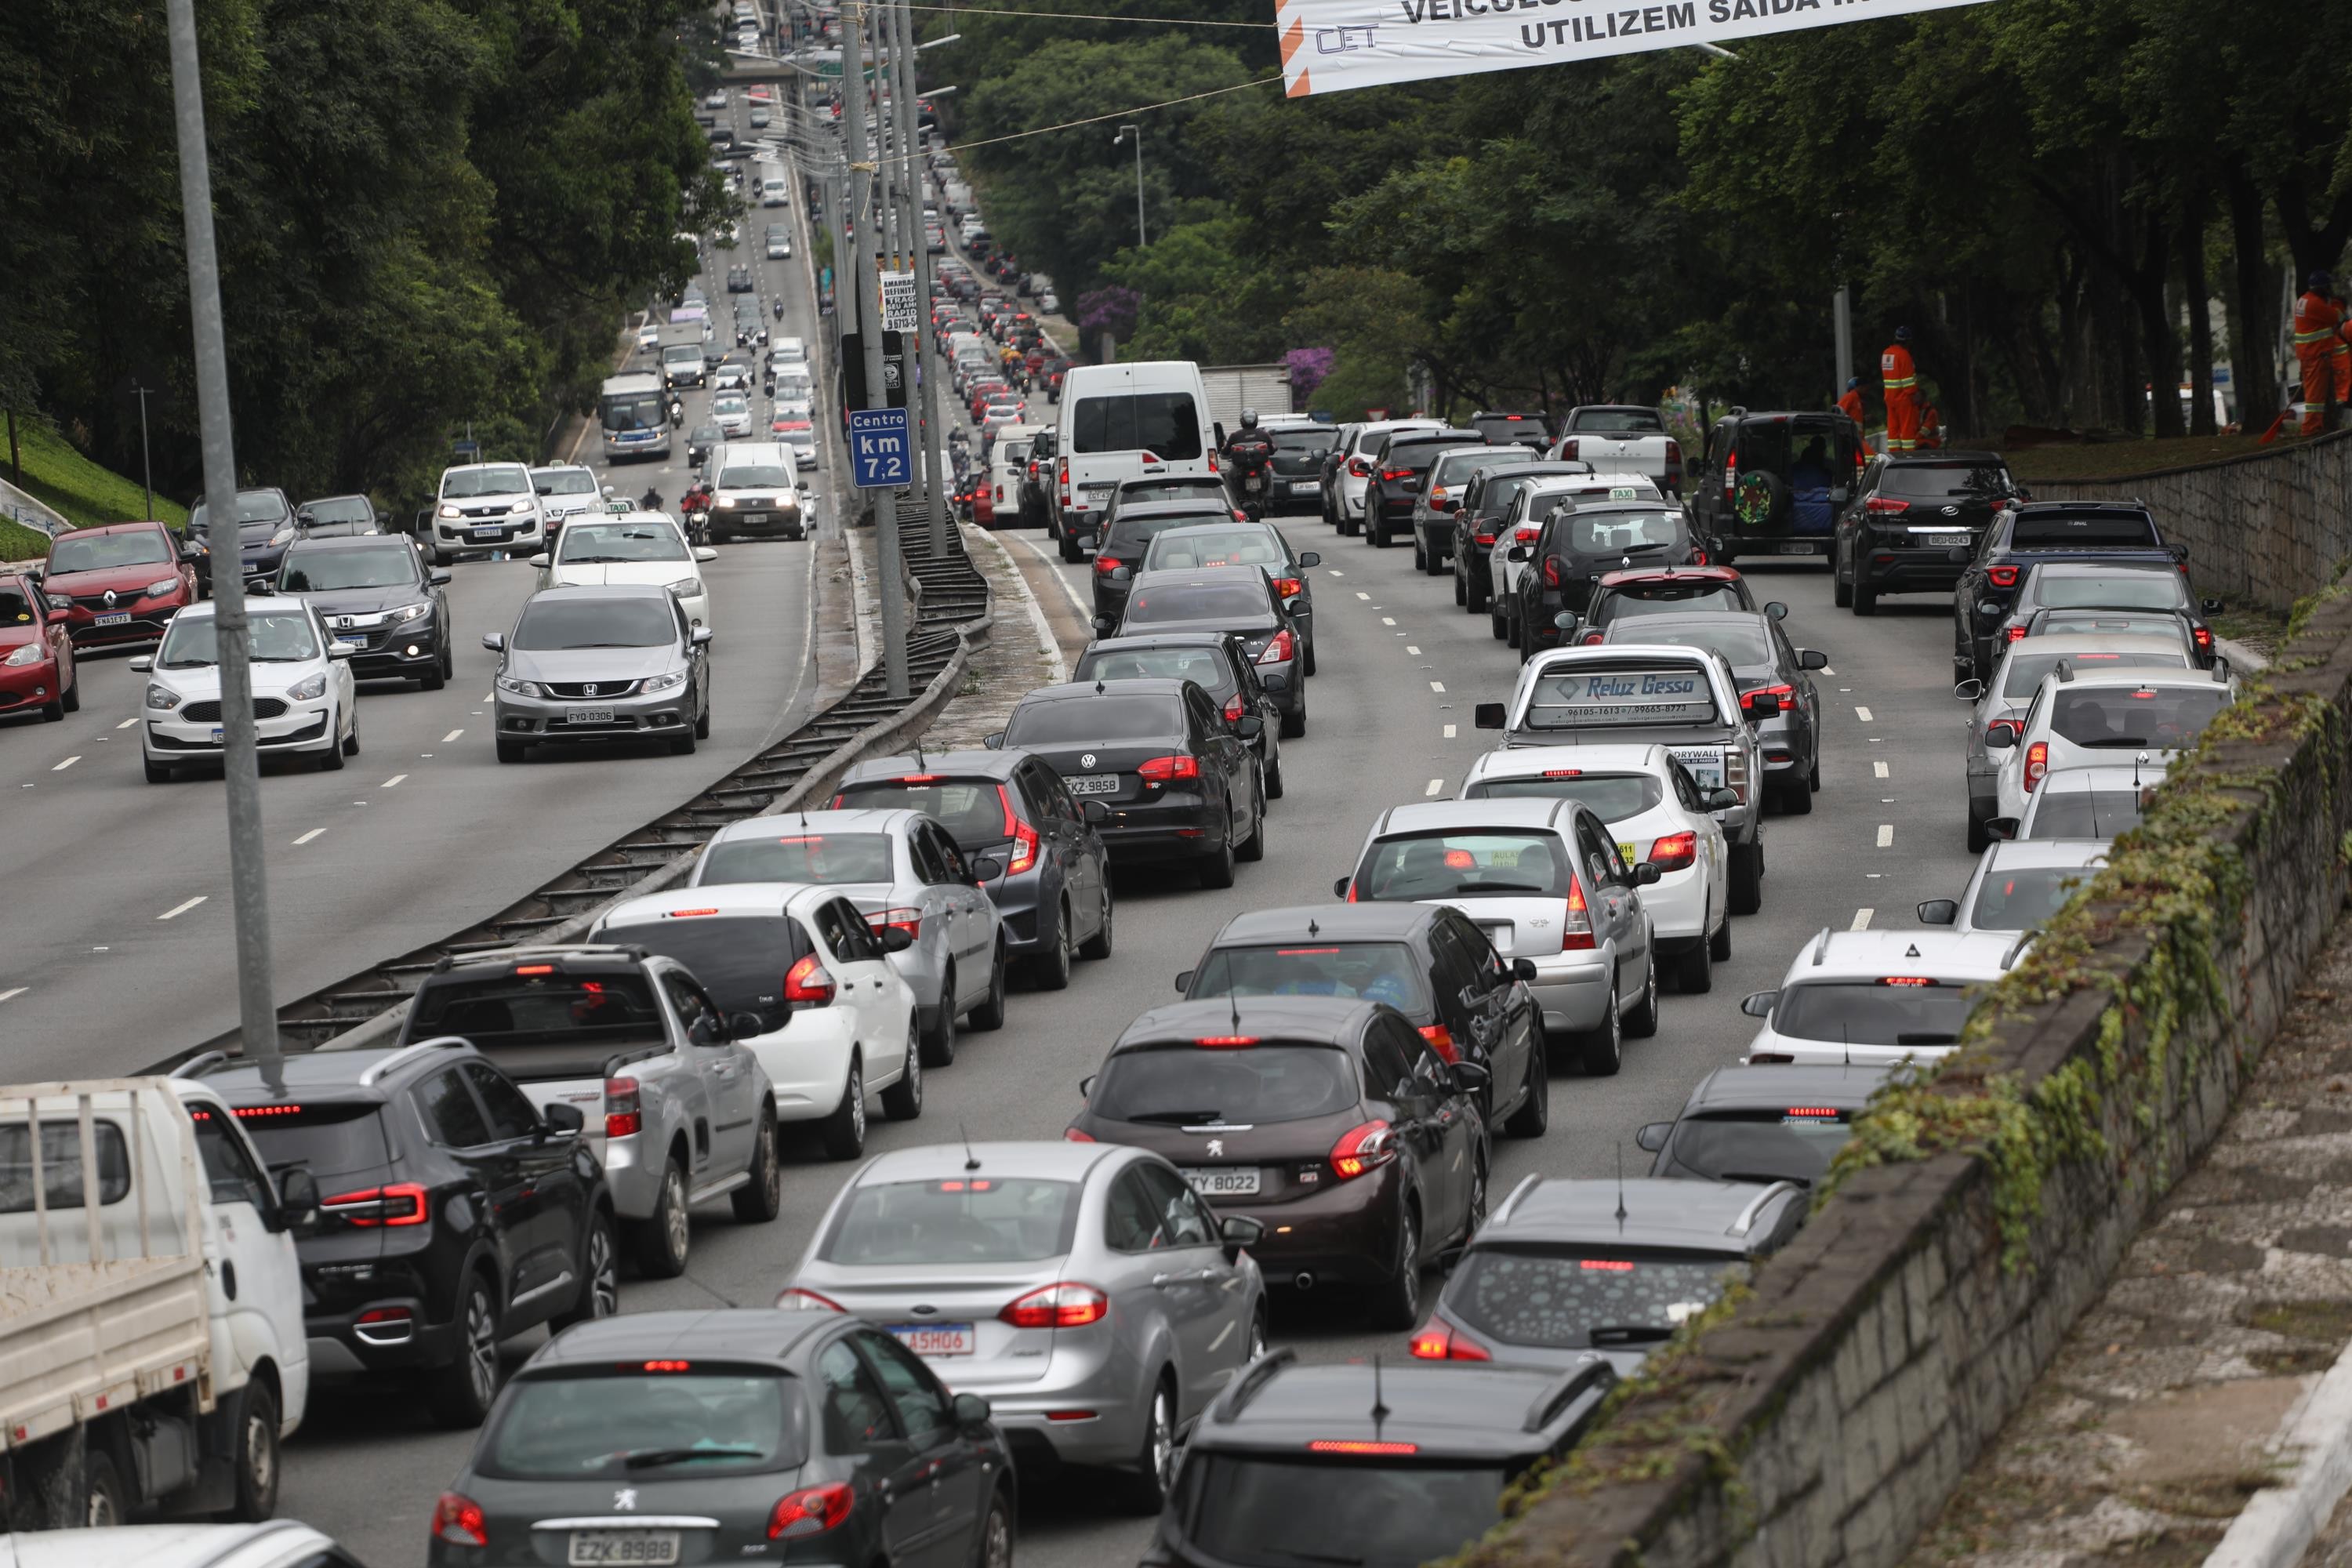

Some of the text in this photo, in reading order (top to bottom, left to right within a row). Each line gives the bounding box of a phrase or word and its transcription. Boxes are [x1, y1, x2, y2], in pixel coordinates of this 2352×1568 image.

[1521, 3, 1696, 49] UTILIZEM
[1316, 23, 1379, 54] CET
[889, 296, 916, 304] TRAG
[887, 310, 917, 318] RAPID
[894, 317, 916, 329] 6713-5
[853, 414, 904, 427] Centro
[860, 435, 900, 454] km
[864, 457, 902, 480] 7,2
[1612, 489, 1632, 498] TAXI
[1587, 674, 1694, 701] Reluz Gesso
[1634, 705, 1686, 713] 99665-8773
[1188, 1176, 1254, 1190] TY-8022
